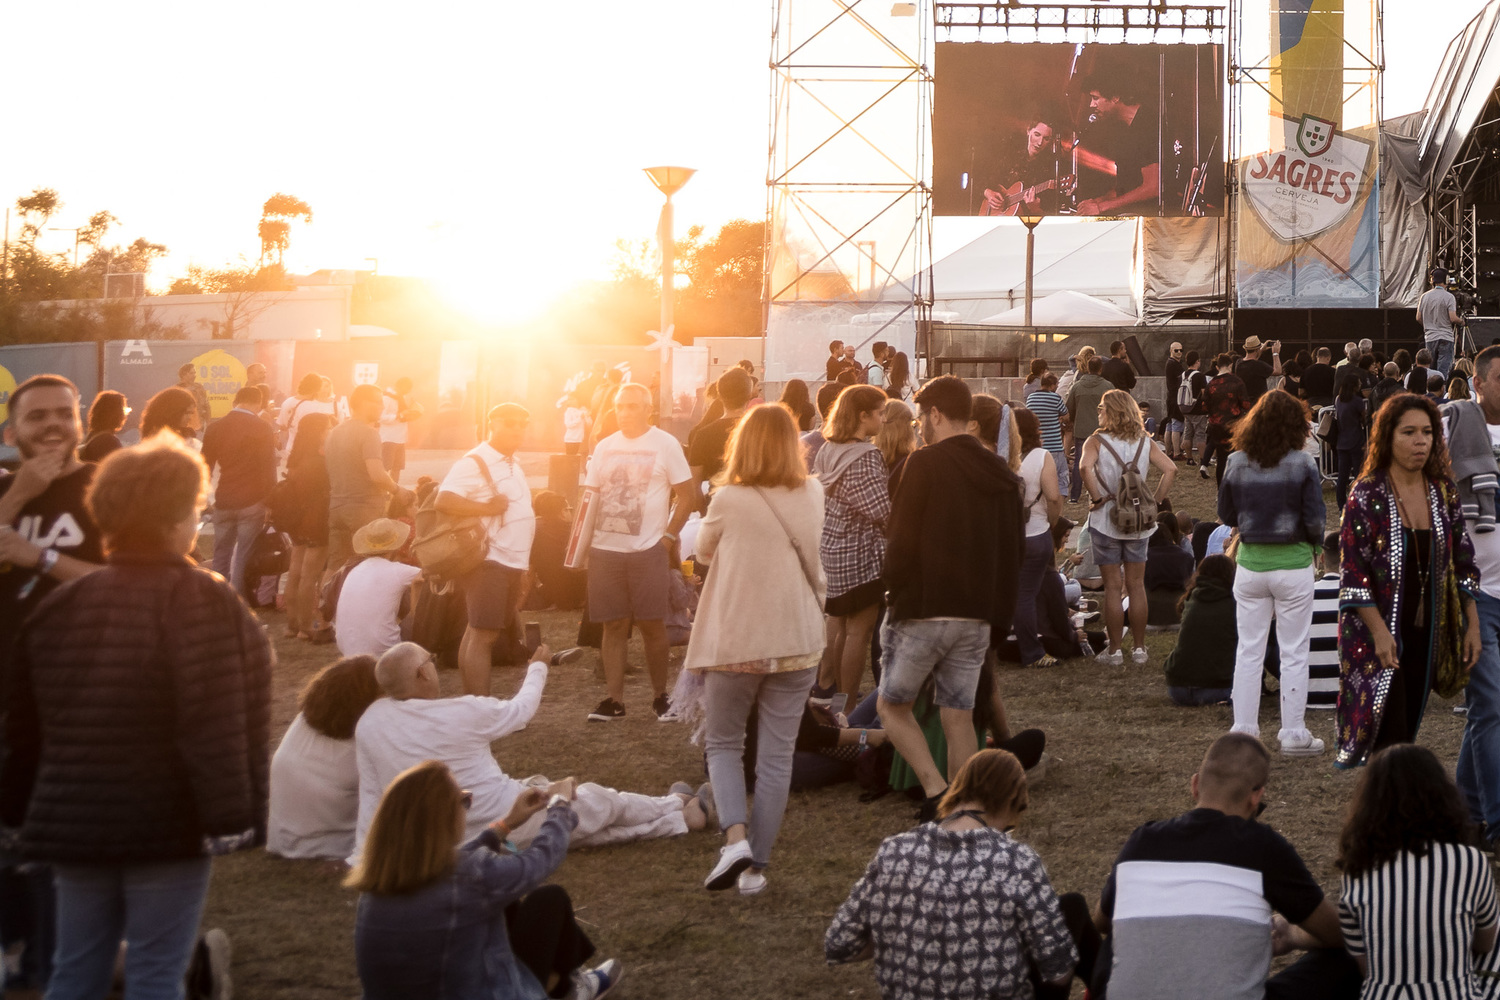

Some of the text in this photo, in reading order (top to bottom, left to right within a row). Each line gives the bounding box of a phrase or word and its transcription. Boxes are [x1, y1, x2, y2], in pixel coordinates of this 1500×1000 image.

[1250, 152, 1356, 204] SAGRES
[1275, 186, 1319, 205] CERVEJA
[19, 512, 85, 548] ILA
